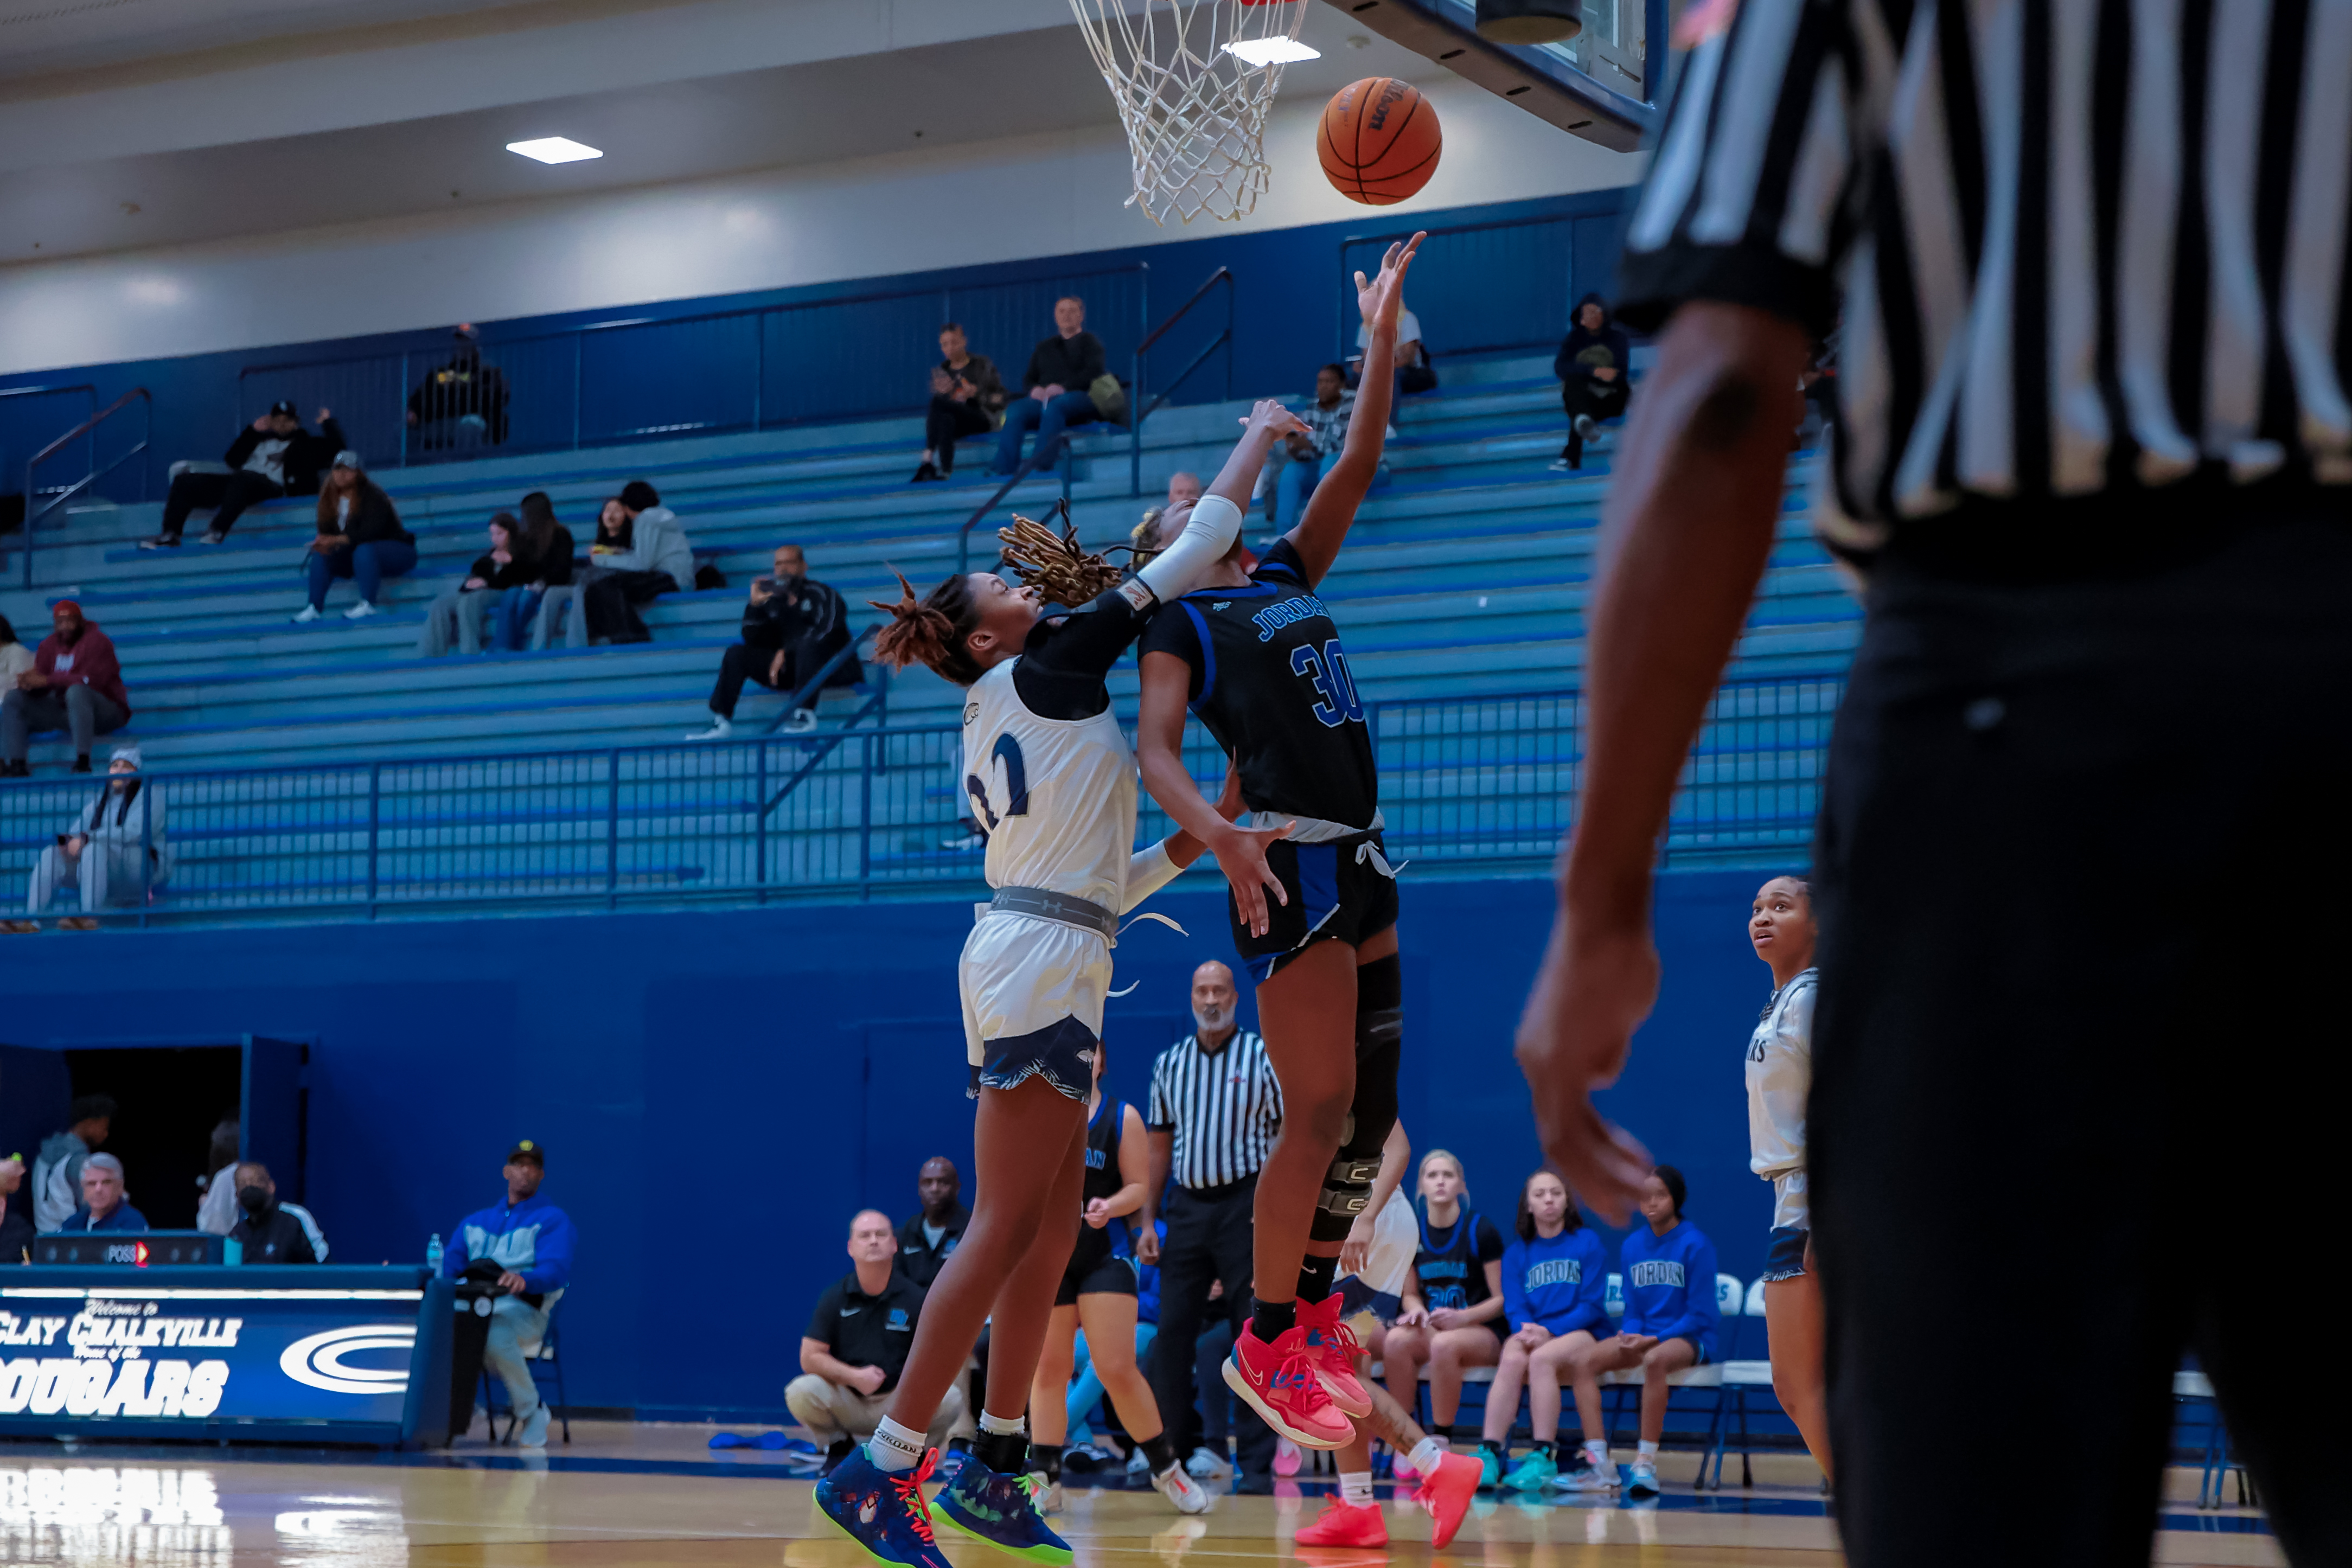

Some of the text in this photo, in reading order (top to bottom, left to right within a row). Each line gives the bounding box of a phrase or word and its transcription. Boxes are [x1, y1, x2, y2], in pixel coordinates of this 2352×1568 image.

[1251, 595, 1331, 642] JORDA
[1290, 638, 1365, 728] 30
[0, 1358, 230, 1418] OUGARS
